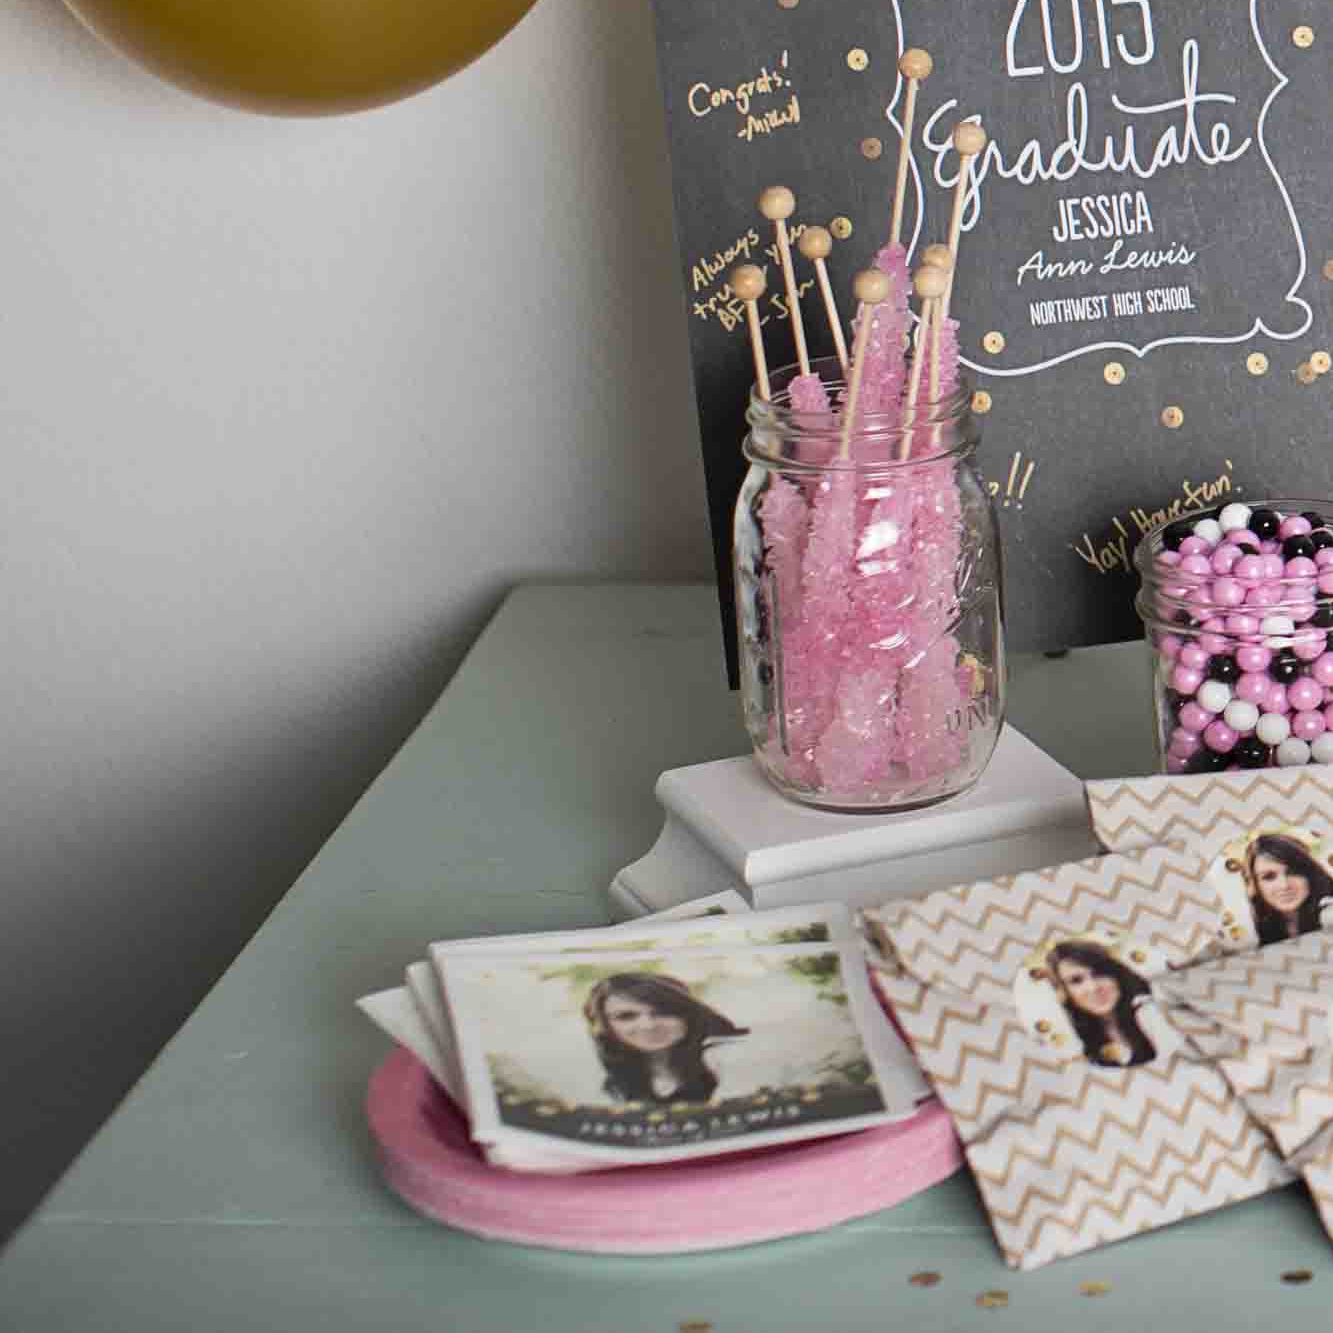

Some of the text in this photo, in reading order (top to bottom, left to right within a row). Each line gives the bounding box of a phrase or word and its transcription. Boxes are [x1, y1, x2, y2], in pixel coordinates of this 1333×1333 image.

[1052, 190, 1154, 243] JESSICA
[1016, 239, 1197, 286] Ann Lewis
[1029, 285, 1196, 326] NORTHWEST HIGH SCHOOL
